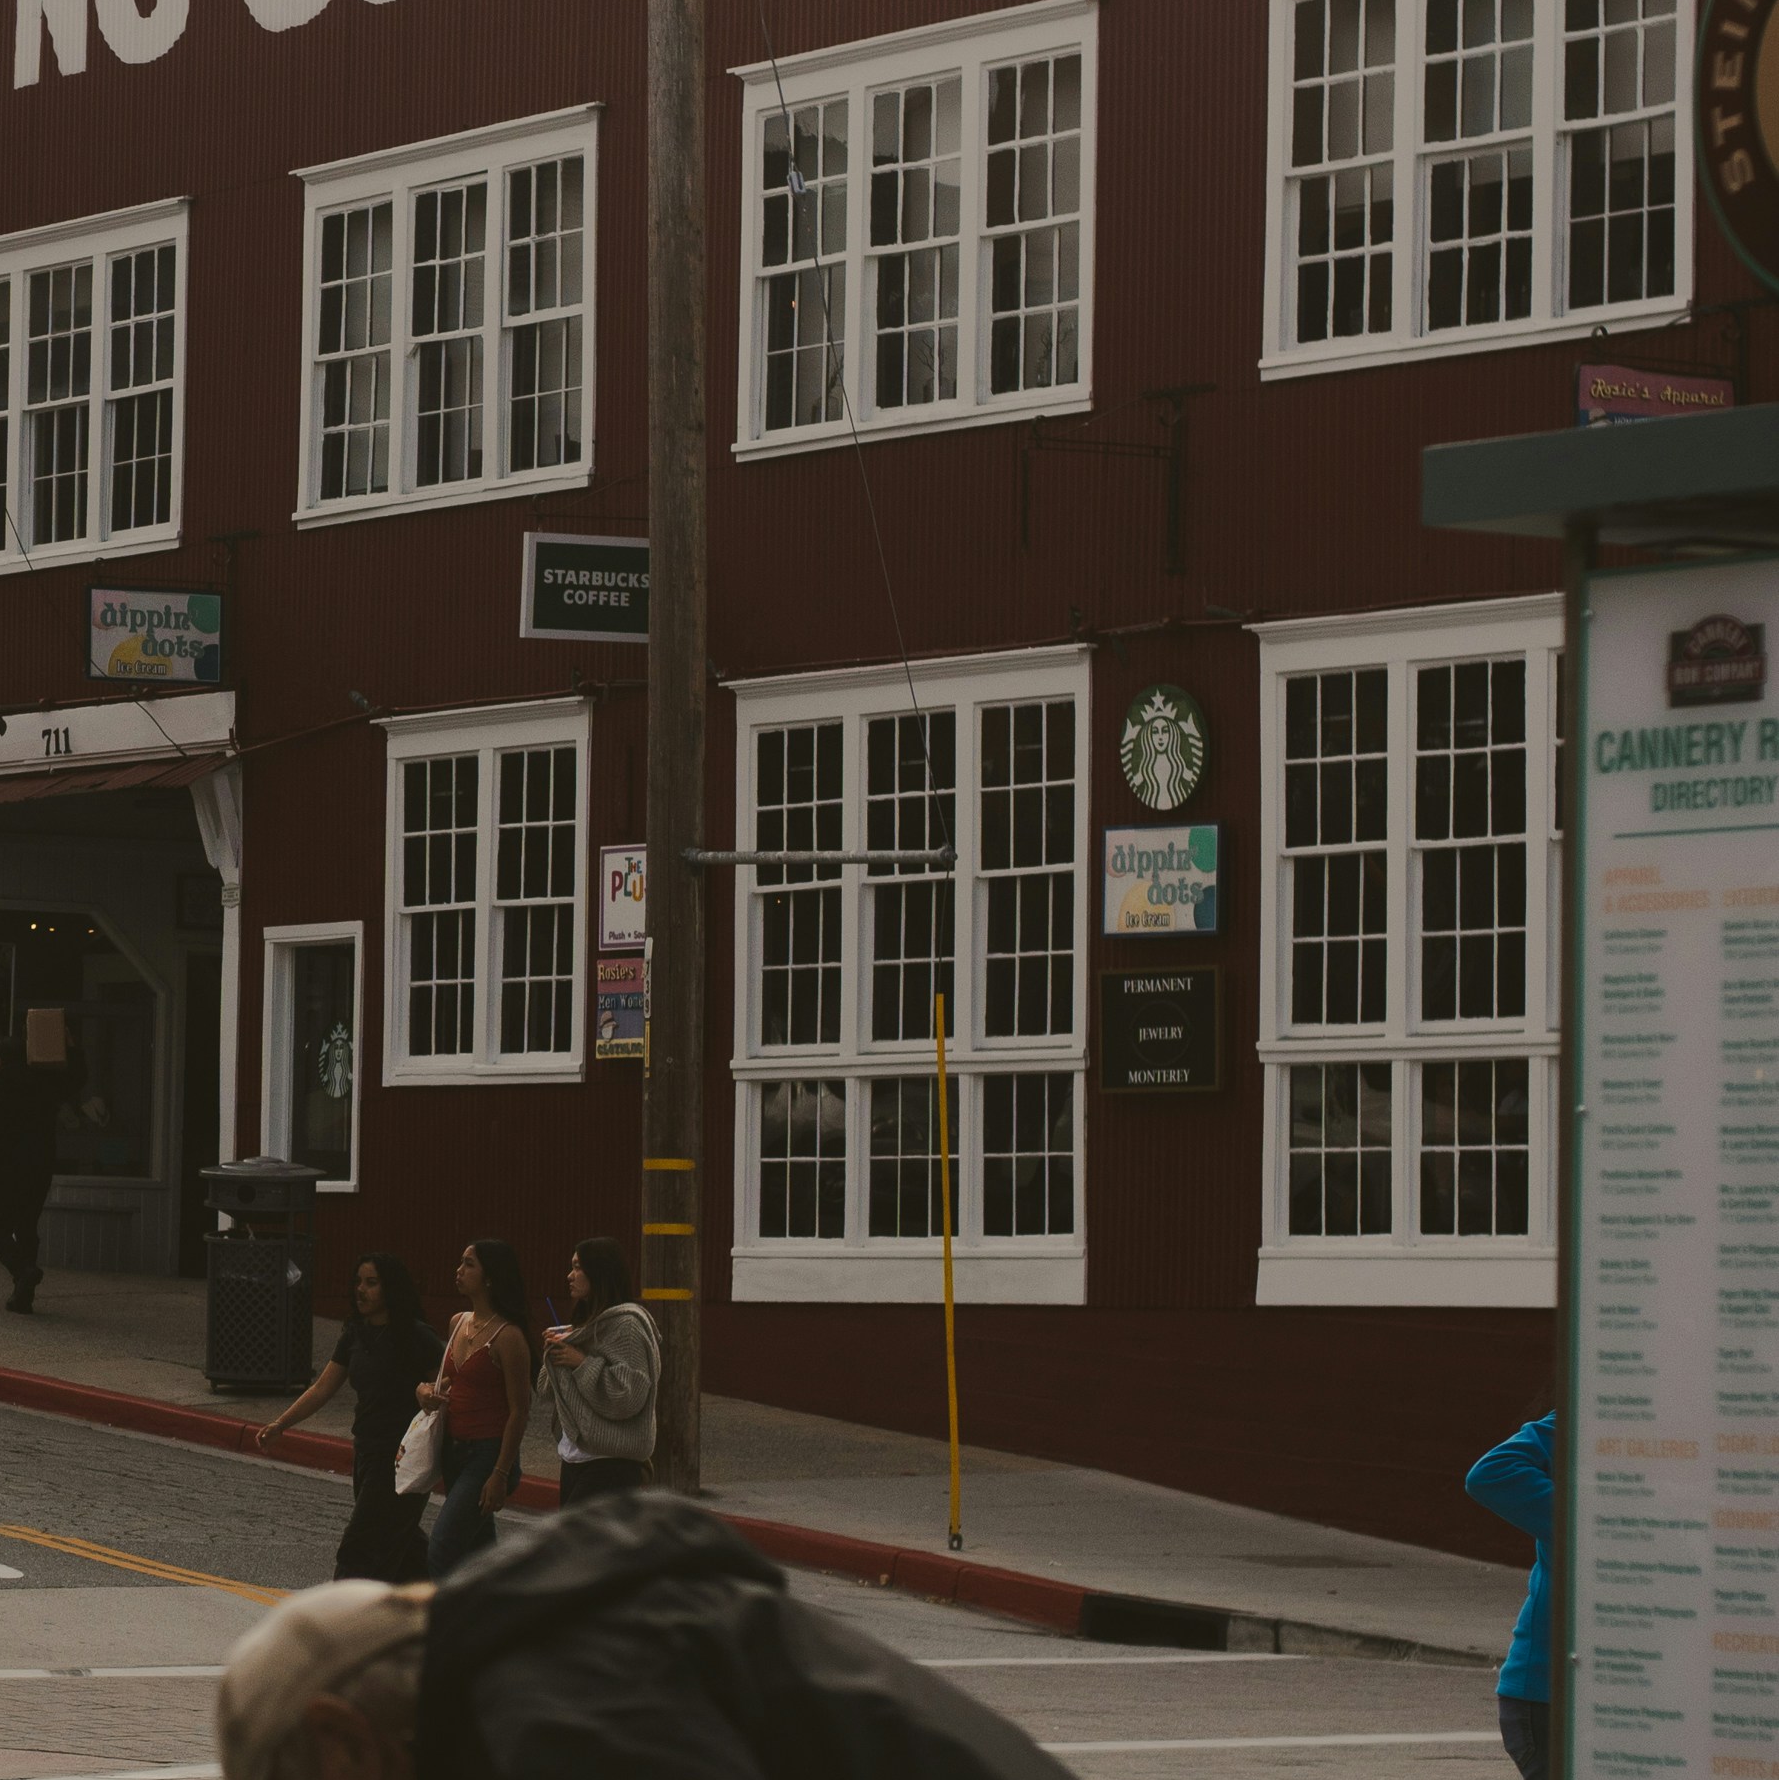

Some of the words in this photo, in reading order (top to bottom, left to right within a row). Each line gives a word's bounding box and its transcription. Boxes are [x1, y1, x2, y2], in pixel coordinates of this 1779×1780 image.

[1590, 377, 1651, 399] Rosie's
[1659, 385, 1725, 406] Apparel
[543, 568, 650, 589] STARBUCKS
[563, 589, 631, 607] COFFEE
[141, 633, 205, 658] dots
[116, 659, 132, 673] Ice
[135, 660, 167, 675] Cream
[41, 727, 72, 757] 711
[1597, 720, 1747, 774] CANNERY
[1652, 775, 1778, 811] DIRECTORY
[625, 857, 642, 875] THE
[1147, 875, 1204, 906] dots
[1143, 911, 1171, 928] Cream
[608, 931, 625, 941] Plush
[598, 964, 636, 981] Rosie's
[1123, 978, 1194, 994] PERMANENT
[598, 994, 616, 1010] Men
[1138, 1027, 1184, 1043] JEWELRY
[1127, 1068, 1190, 1084] MONTEREY
[1596, 1437, 1623, 1455] ART
[1626, 1438, 1700, 1459] GALLERIES
[1712, 1756, 1767, 1778] SPORTS
